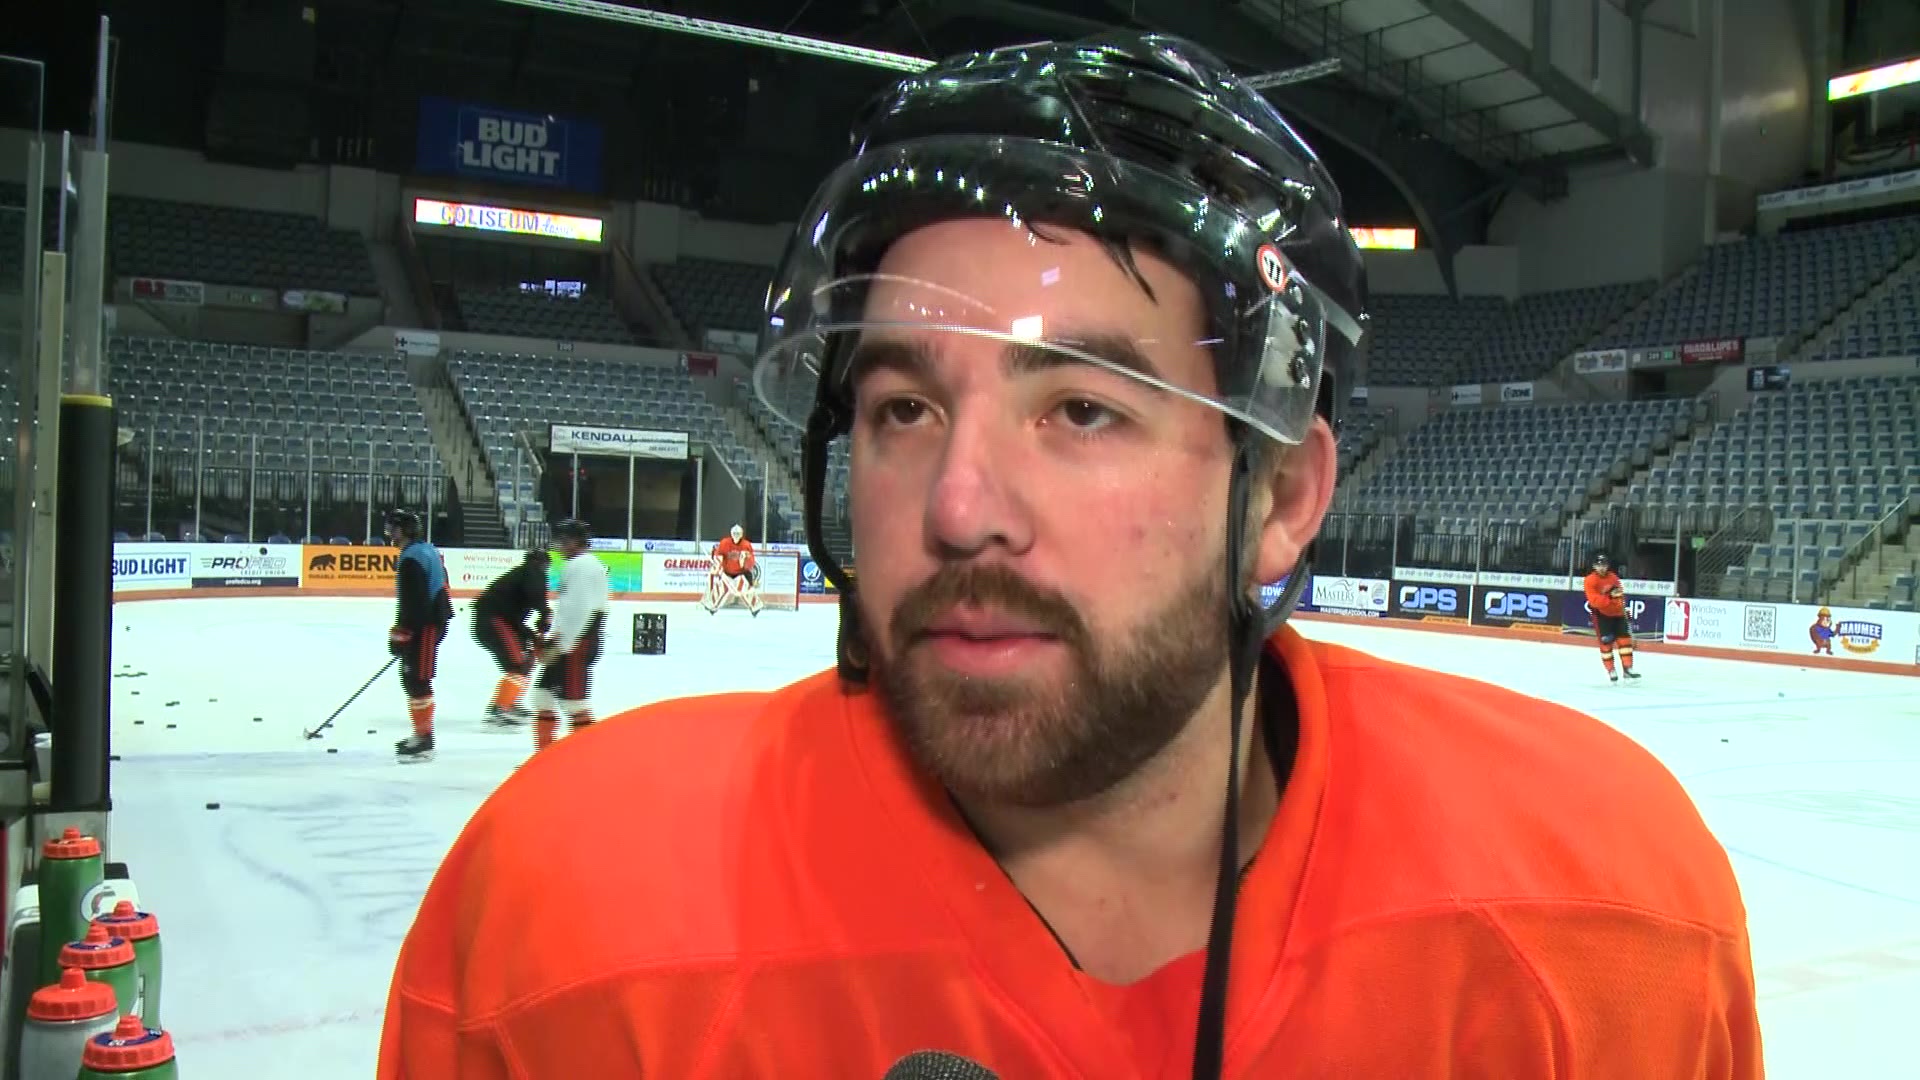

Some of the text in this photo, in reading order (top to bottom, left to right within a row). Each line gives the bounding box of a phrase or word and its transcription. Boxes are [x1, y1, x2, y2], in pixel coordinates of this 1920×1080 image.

[478, 117, 548, 148] BUD
[463, 140, 560, 176] LIGHT
[441, 205, 540, 232] COLISEUM
[571, 431, 637, 443] KENDALL
[112, 558, 187, 576] BUD LIGHT
[339, 554, 398, 571] BERN
[664, 558, 711, 569] GLENBR
[1315, 585, 1355, 600] MASTERS
[1399, 586, 1457, 611] OPS
[1485, 591, 1549, 618] OPS
[1691, 604, 1727, 615] Windows
[1696, 616, 1720, 626] Doors
[1701, 629, 1722, 639] More
[1840, 622, 1881, 638] MAUMEE
